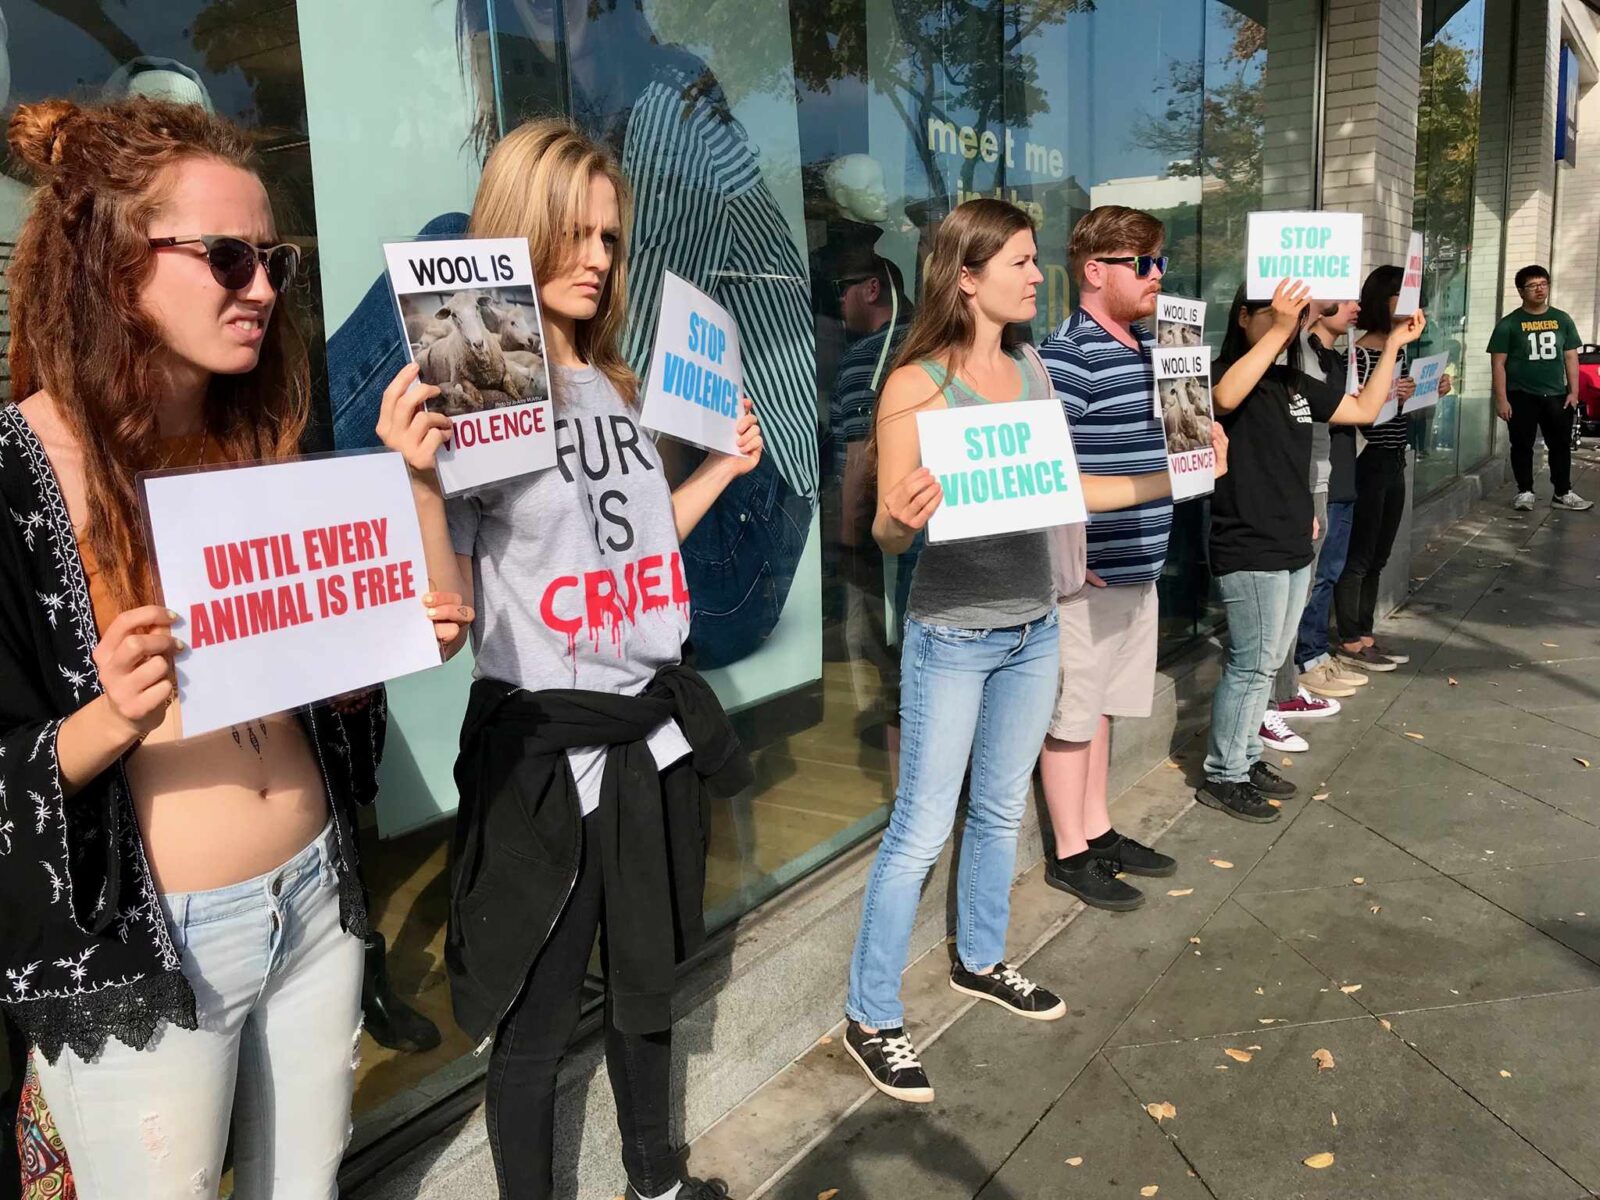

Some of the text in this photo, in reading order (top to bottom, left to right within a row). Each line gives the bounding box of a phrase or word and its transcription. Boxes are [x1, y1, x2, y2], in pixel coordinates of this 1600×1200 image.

[928, 118, 1063, 178] meet me
[1281, 226, 1332, 250] STOP
[408, 254, 514, 286] WOOL IS
[1258, 255, 1350, 278] VIOLENCE
[1163, 304, 1198, 322] WOOL IS
[1521, 320, 1559, 331] PACKERS
[688, 311, 727, 365] STOP
[1527, 331, 1557, 361] 18
[1161, 356, 1202, 375] WOOL IS
[663, 352, 739, 419] VIOLENCE
[443, 407, 546, 451] IOLENCE
[964, 422, 1031, 461] STOP
[554, 415, 654, 483] FUR
[1171, 451, 1213, 474] VIOLENCE
[940, 460, 1068, 507] VIOLENCE
[203, 517, 388, 590] UNTIL EVERY
[189, 560, 416, 649] ANIMAL IS FREE
